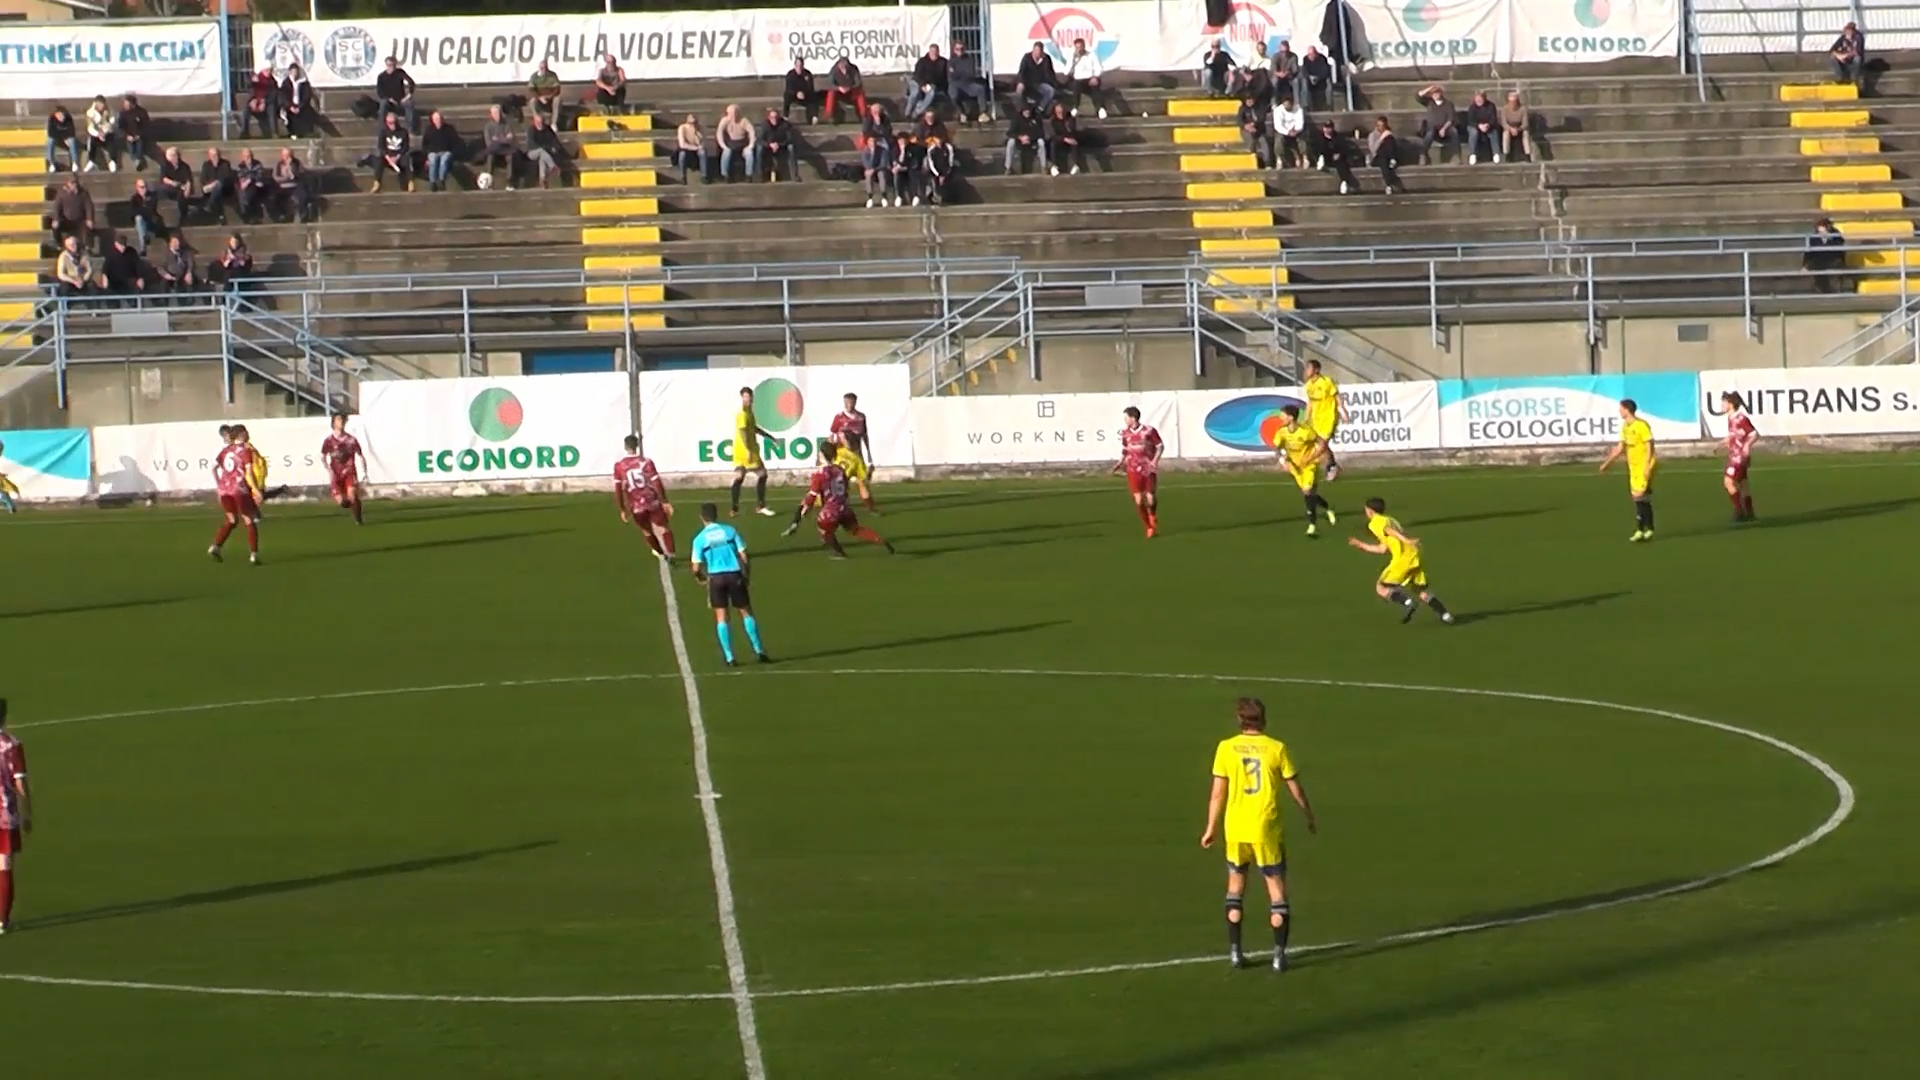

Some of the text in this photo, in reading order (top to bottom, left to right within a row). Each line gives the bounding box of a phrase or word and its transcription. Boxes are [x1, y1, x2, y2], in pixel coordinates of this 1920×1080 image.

[393, 37, 429, 66] UN
[438, 35, 535, 66] CALCIO
[543, 33, 608, 63] ALLA
[620, 29, 752, 61] VIOLENZA
[788, 29, 900, 46] OLGA FIORINI
[1371, 38, 1477, 58] ECONORD
[1539, 36, 1647, 53] ECONORD
[789, 45, 921, 60] MARCO PANTANI
[1468, 397, 1566, 419] RISORSE
[1706, 386, 1881, 416] UNITRANS
[1469, 417, 1620, 440] ECOLOGICHE
[223, 451, 236, 472] 6
[418, 445, 580, 473] ECONORD
[626, 469, 647, 492] 15
[1242, 757, 1261, 795] 3
